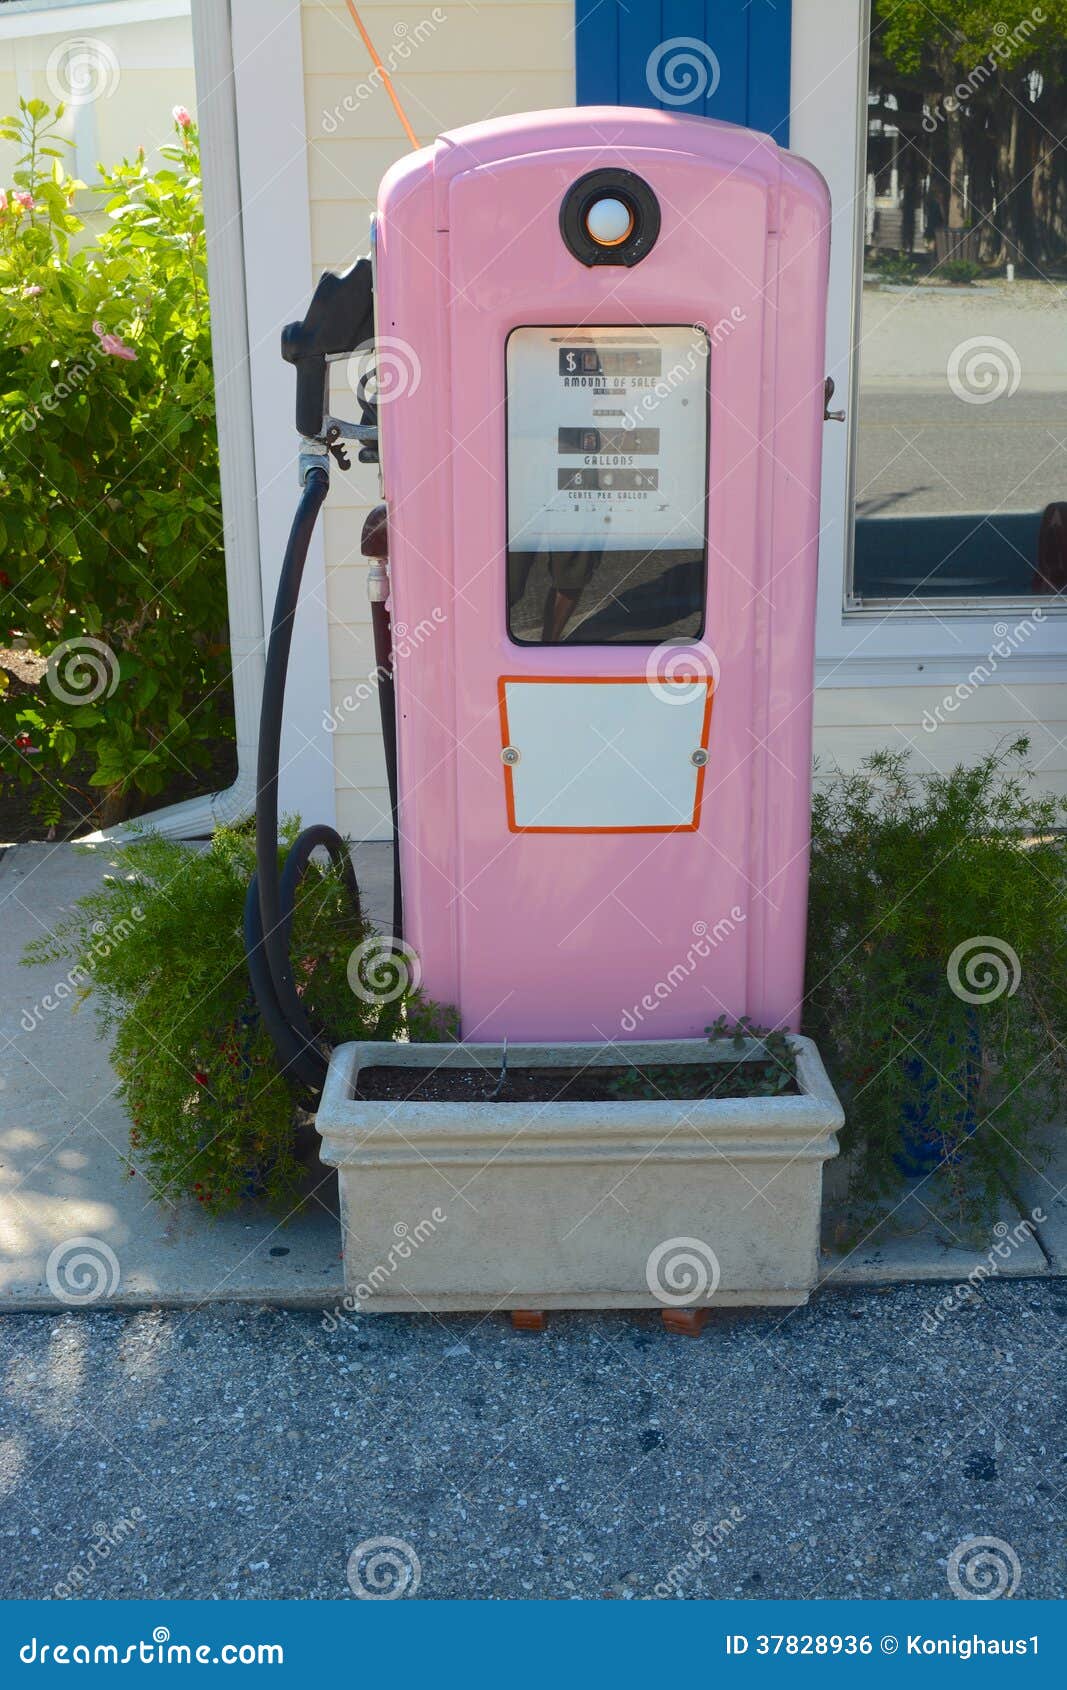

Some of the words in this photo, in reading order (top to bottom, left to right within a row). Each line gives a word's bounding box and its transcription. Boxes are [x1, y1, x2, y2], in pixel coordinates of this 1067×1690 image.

[564, 377, 608, 388] AMOUNT
[613, 377, 626, 388] OF
[631, 377, 656, 388] SALE
[584, 455, 633, 465] GALLONS
